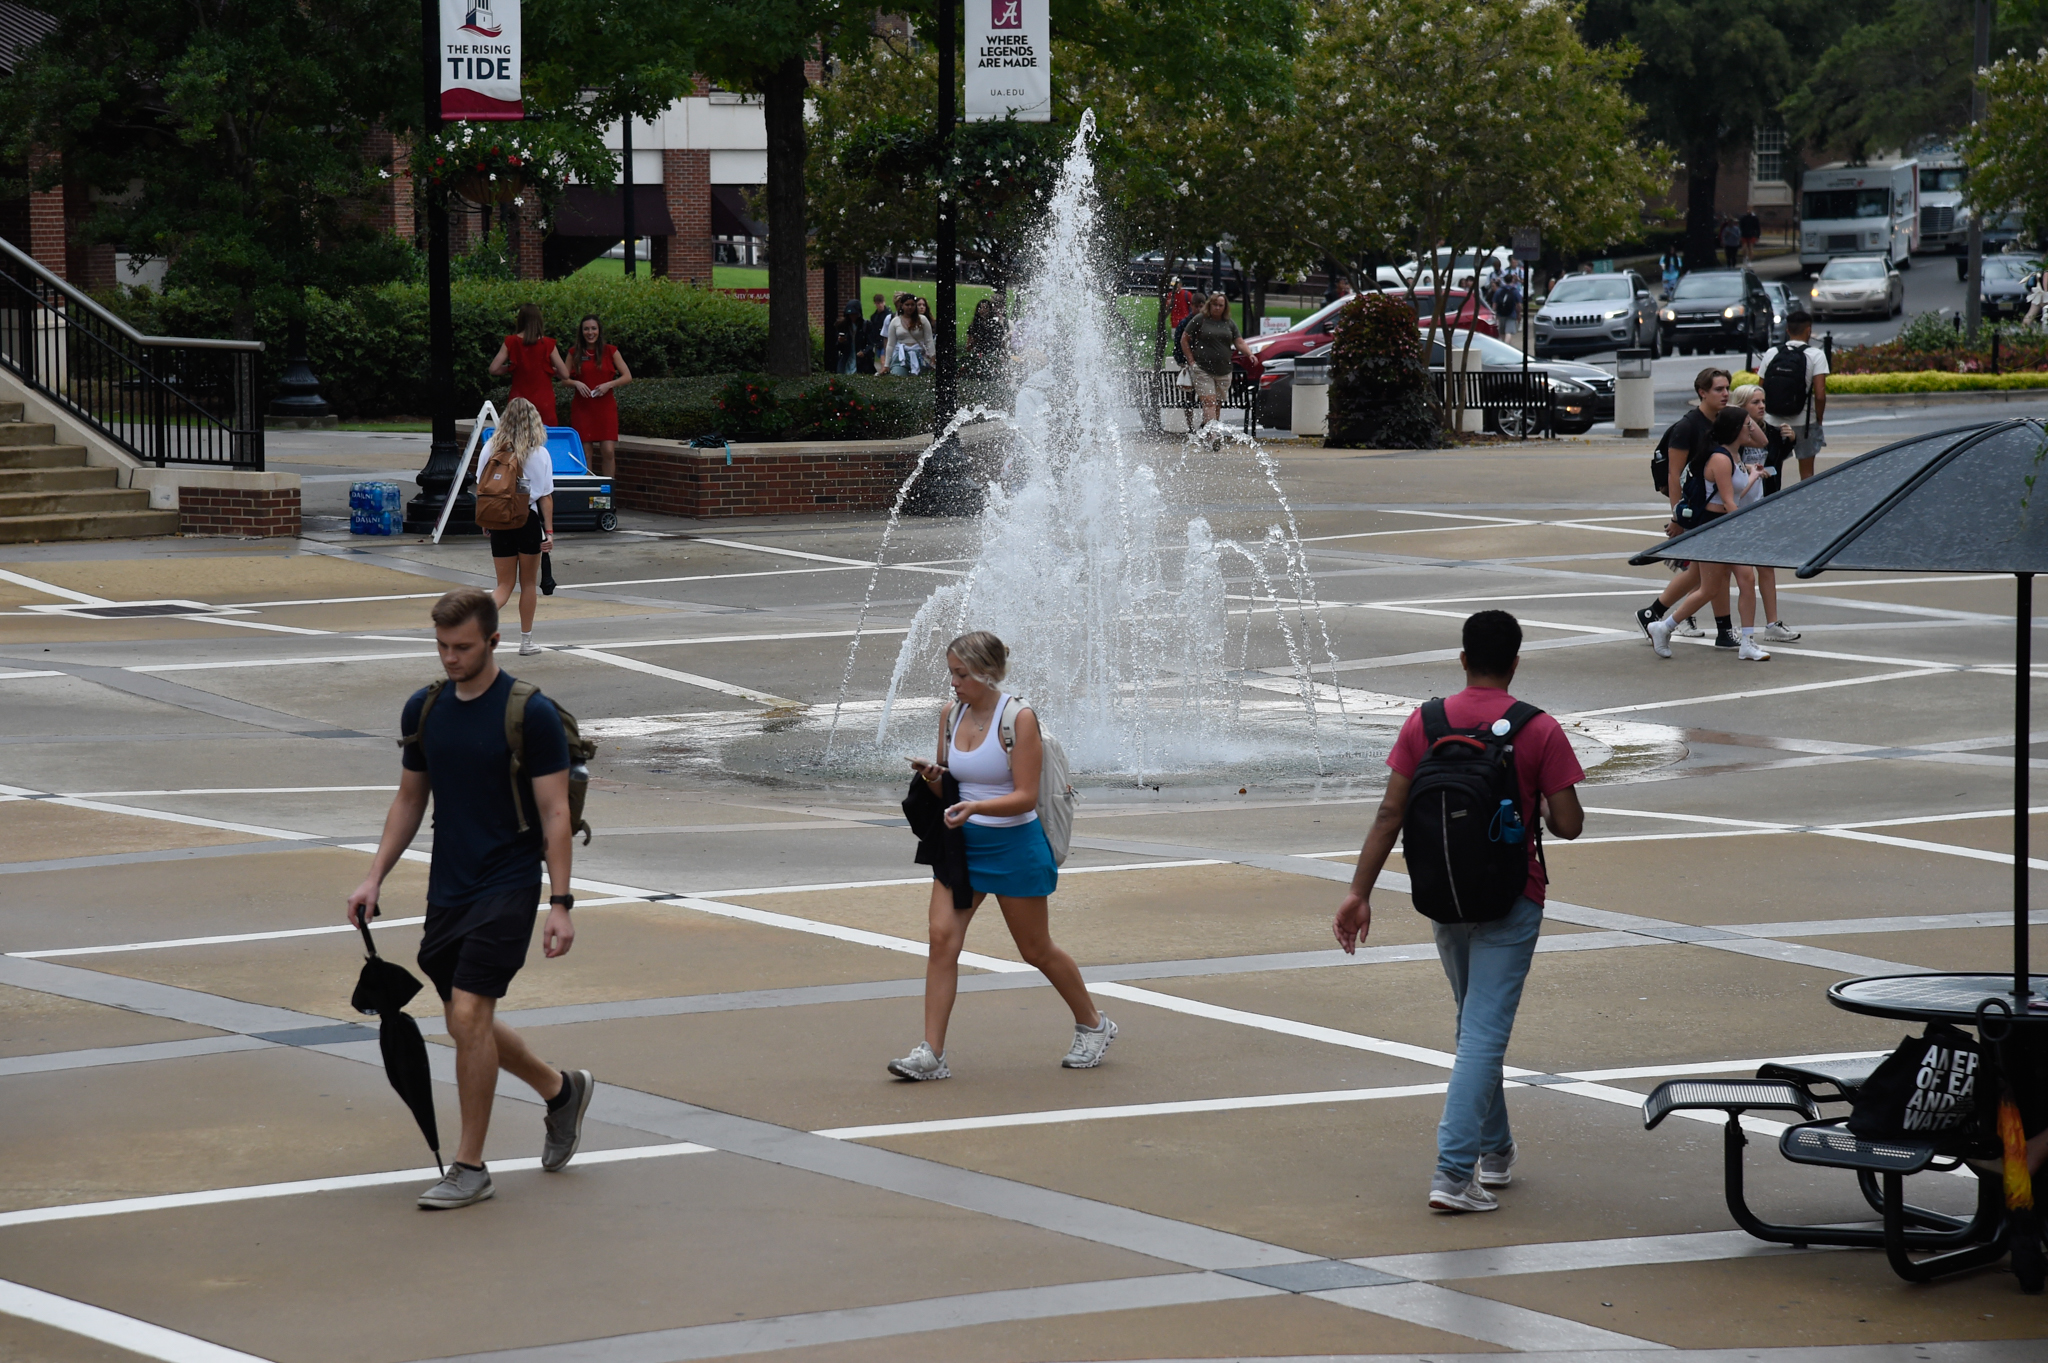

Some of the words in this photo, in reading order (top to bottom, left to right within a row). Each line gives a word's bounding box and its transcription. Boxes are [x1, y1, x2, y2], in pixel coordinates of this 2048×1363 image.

[986, 35, 1028, 45] WHERE
[447, 45, 468, 54] THE
[472, 45, 511, 54] RISING
[980, 46, 1034, 57] LEGENDS
[447, 57, 511, 80] TIDE
[978, 58, 1001, 68] ARE
[1003, 57, 1037, 68] MADE
[1916, 1066, 1945, 1091] OF
[1906, 1088, 1956, 1113] AND
[1902, 1107, 1967, 1131] WATER
